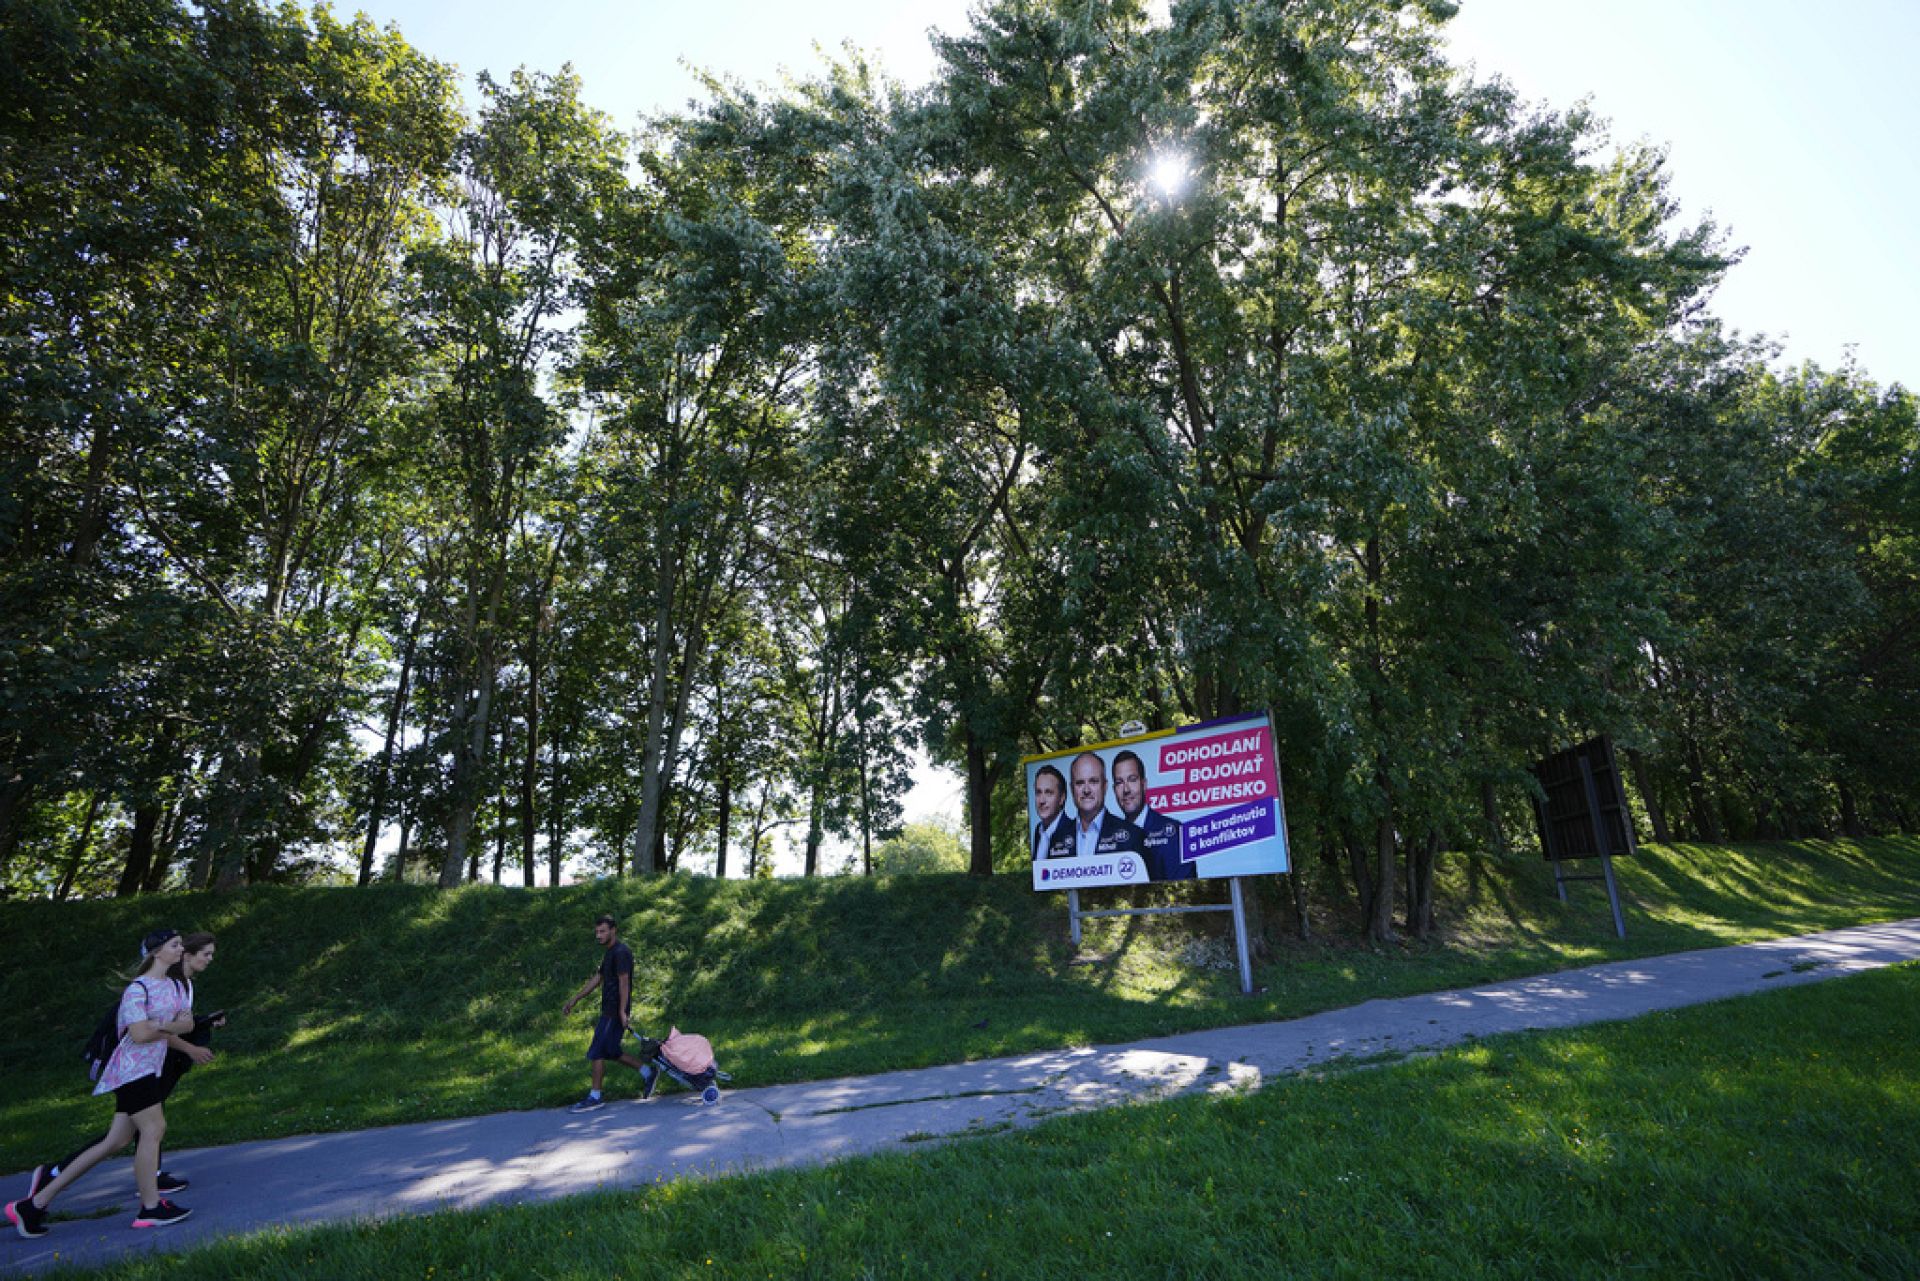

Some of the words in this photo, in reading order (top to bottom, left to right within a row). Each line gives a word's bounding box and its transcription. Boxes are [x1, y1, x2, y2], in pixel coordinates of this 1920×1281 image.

[1165, 731, 1262, 766] ODHODLANÍ
[1189, 754, 1264, 783] BOJOVAŤ
[1150, 795, 1168, 809] ZA
[1172, 780, 1267, 806] SLOVENSKO
[1188, 824, 1208, 838] Bez
[1211, 806, 1267, 832] kradnutia
[1189, 842, 1197, 851] a
[1199, 825, 1256, 849] konfliktov
[1051, 864, 1113, 880] DEMOKRATI
[1120, 862, 1133, 873] 22
